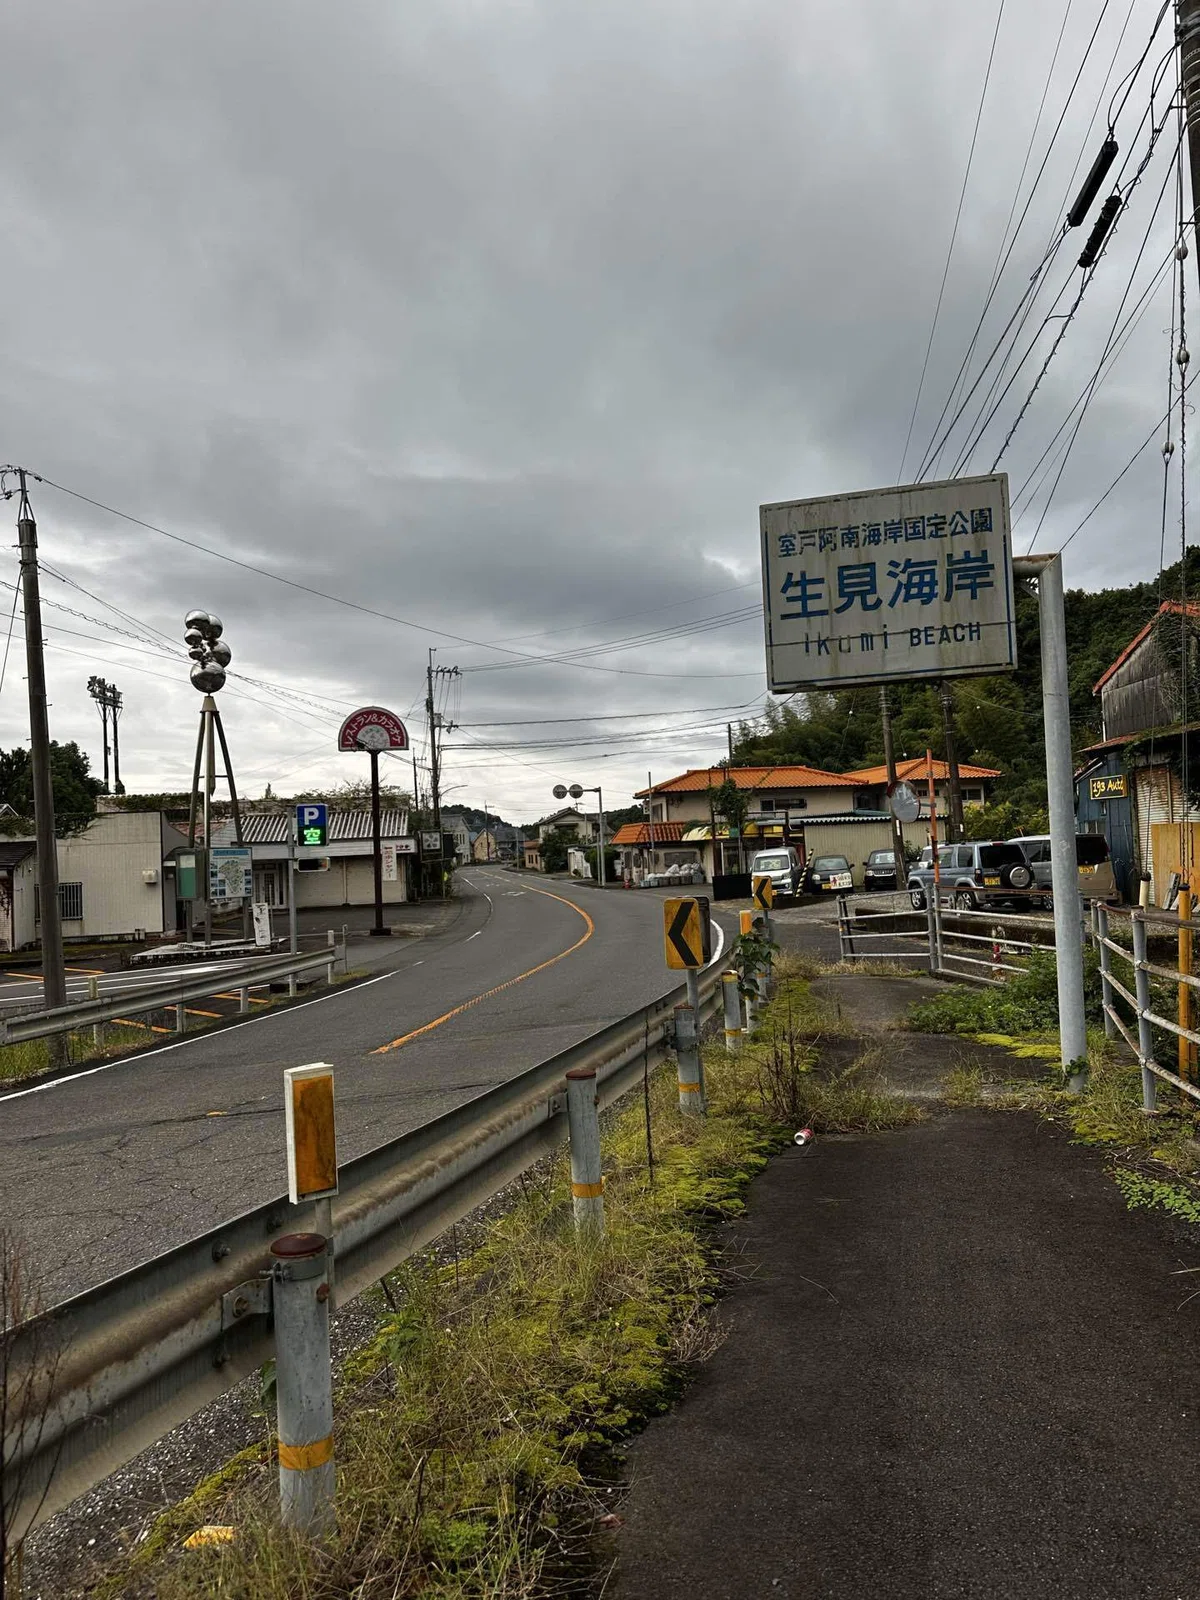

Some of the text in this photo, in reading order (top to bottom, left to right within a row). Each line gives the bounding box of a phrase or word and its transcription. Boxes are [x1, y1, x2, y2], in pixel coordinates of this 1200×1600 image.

[778, 507, 993, 558] 室戸阿南海岸国定公園
[780, 550, 995, 620] 生見海岸
[910, 621, 981, 647] BEACH
[1093, 781, 1106, 797] 193
[304, 807, 319, 825] P
[303, 827, 321, 845] 空
